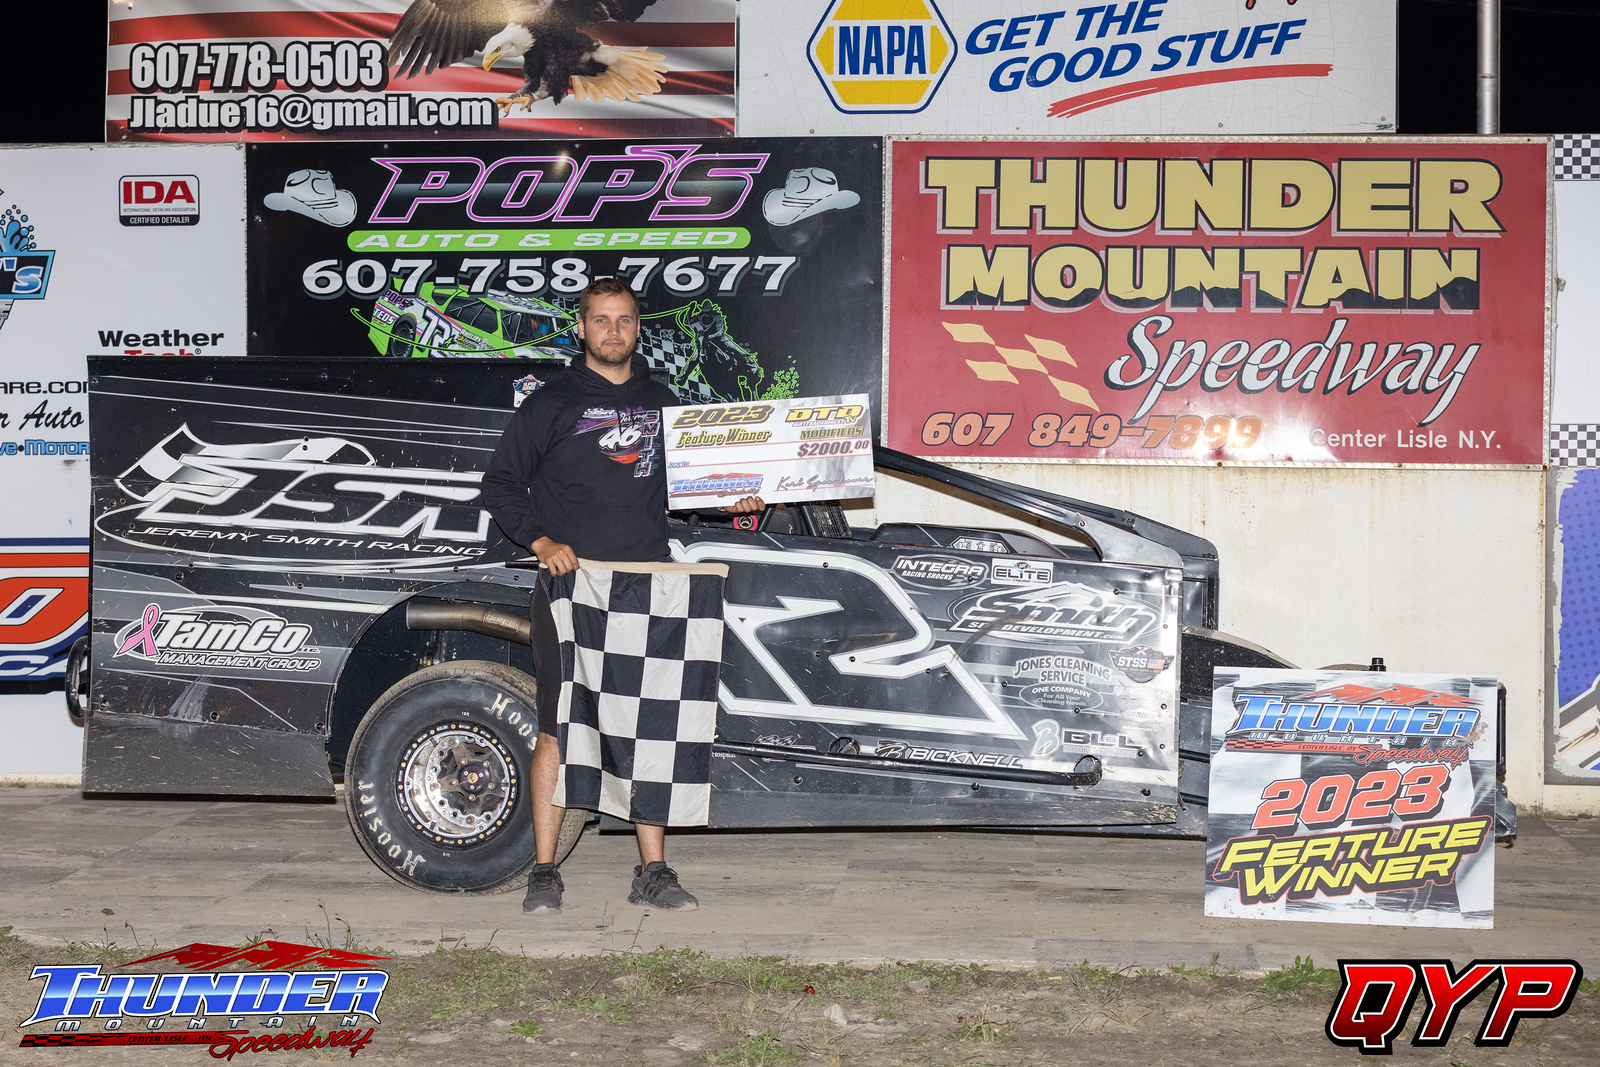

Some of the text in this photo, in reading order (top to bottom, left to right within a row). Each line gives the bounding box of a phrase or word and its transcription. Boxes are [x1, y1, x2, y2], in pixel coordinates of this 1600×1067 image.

[965, 0, 1168, 55] GET THE
[838, 25, 927, 75] NAPA
[988, 19, 1307, 93] GOOD STUFF
[130, 42, 386, 90] 607-778-0503
[130, 97, 494, 131] Jladue16@gmail.com
[123, 180, 196, 204] IDA
[921, 156, 1507, 235] THUNDER
[129, 216, 190, 224] CERTIFIED DETAILER
[355, 231, 738, 248] AUTO & SPEED
[302, 255, 799, 297] 607-758-7677
[941, 244, 1480, 313] MOUNTAIN
[98, 329, 224, 348] Weather
[1104, 315, 1481, 428] Speedway
[19, 399, 84, 430] Auto
[672, 404, 774, 428] 2023
[598, 424, 642, 450] 46
[676, 427, 773, 448] Feature Winner
[800, 426, 864, 440] MODIFIEDS
[921, 412, 1264, 449] 607 849-7899
[1309, 428, 1501, 449] Center Lisle N.Y.
[127, 526, 488, 556] JEREMY SMITH RACING
[897, 559, 985, 576] INTEGRA
[901, 570, 926, 578] RACING
[154, 611, 312, 656] TamCo
[161, 652, 322, 671] MANAGEMENT GROUP
[1014, 657, 1111, 680] JONES CLEANING
[1117, 656, 1148, 669] STSS
[1040, 670, 1085, 685] SERVICE
[1031, 686, 1092, 698] ONE COMPANY
[1037, 698, 1064, 706] Cleaning
[1226, 694, 1481, 738] THUNDER
[1250, 730, 1459, 748] MOUNTAIN
[908, 749, 1023, 769] BICKNELL
[1354, 744, 1470, 770] Speedway
[1251, 763, 1451, 834] 2023
[1220, 820, 1487, 872] FEATURE
[1244, 851, 1458, 897] WINNER
